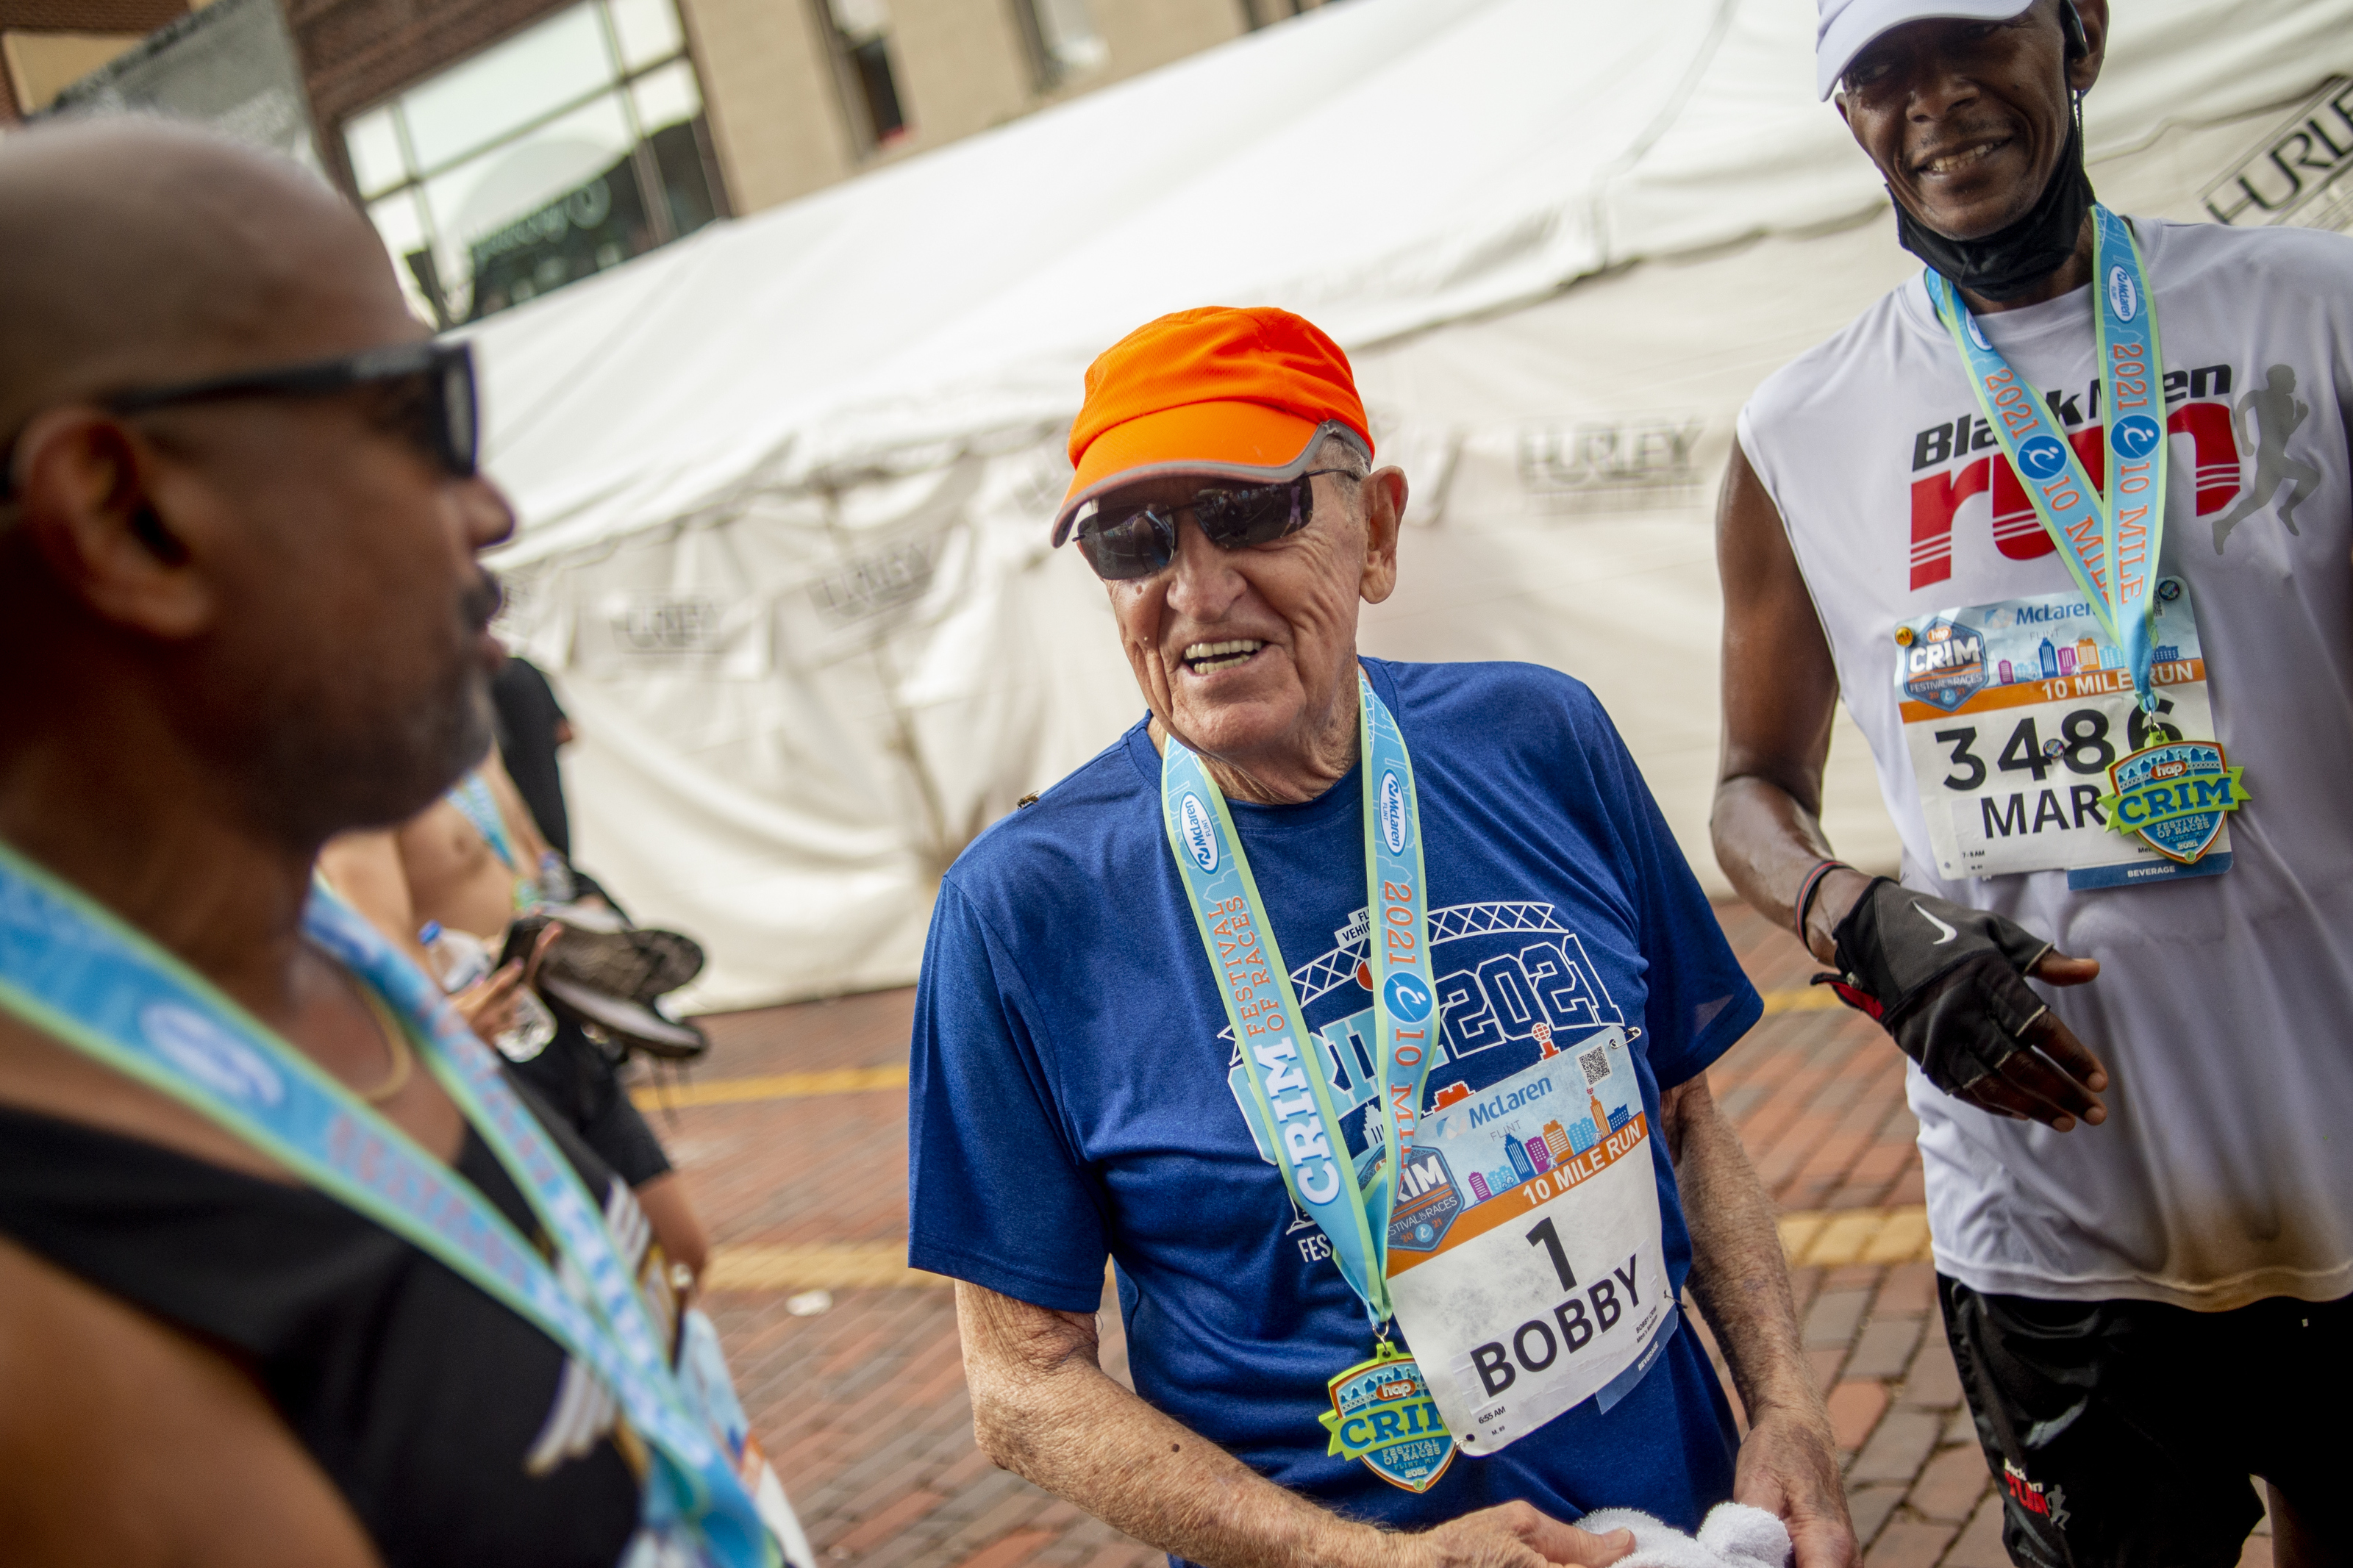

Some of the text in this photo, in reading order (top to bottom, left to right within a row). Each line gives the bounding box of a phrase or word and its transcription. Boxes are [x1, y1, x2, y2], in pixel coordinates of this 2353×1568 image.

[2118, 282, 2130, 317] McLaren
[2113, 343, 2148, 411] 2021
[1985, 368, 2039, 440] 2021
[2042, 475, 2080, 512] 10
[2118, 460, 2150, 605] 10 MILE
[1931, 627, 1949, 641] hap
[2029, 627, 2059, 641] FLINT
[1910, 636, 1981, 673] CRIM
[1910, 679, 1946, 693] FESTIVAL
[1953, 673, 1982, 686] RACES
[2042, 679, 2068, 701] 10
[2074, 670, 2132, 696] MILE
[1935, 698, 2184, 791] 3486
[2157, 763, 2183, 777] hap
[2118, 777, 2234, 825] CRIM
[1185, 801, 1207, 847] McLaren
[1201, 819, 1212, 837] FLINT
[1389, 797, 1400, 847] McLaren
[2156, 814, 2208, 831] FESTIVAL
[2157, 821, 2210, 838] OF RACES
[2177, 840, 2199, 850] 2021
[2127, 865, 2175, 878] BEVERAGE
[1385, 880, 1416, 964] 2021
[1208, 902, 1266, 1038] FESTIVAL
[1226, 895, 1285, 1031] OF RACES
[1435, 933, 1626, 1059] 2021
[1395, 1028, 1424, 1067] 10
[1469, 1077, 1553, 1130] McLaren
[1253, 1037, 1340, 1206] CRIM
[1490, 1120, 1521, 1142] FLINT
[1523, 1120, 1641, 1205] 10 MILE RUN
[1425, 1196, 1457, 1217] RACES
[1402, 1217, 1443, 1243] 20 21
[1525, 1217, 1577, 1292] 1
[1470, 1253, 1640, 1398] BOBBY
[1635, 1316, 1649, 1333] BOBBY
[1638, 1340, 1659, 1372] BEVERAGE
[1383, 1382, 1411, 1397] hap
[1478, 1406, 1506, 1424] 6:55 AM
[1382, 1439, 1439, 1458] FESTIVAL
[1384, 1447, 1440, 1465] OF RACES
[1404, 1466, 1429, 1478] 2021
